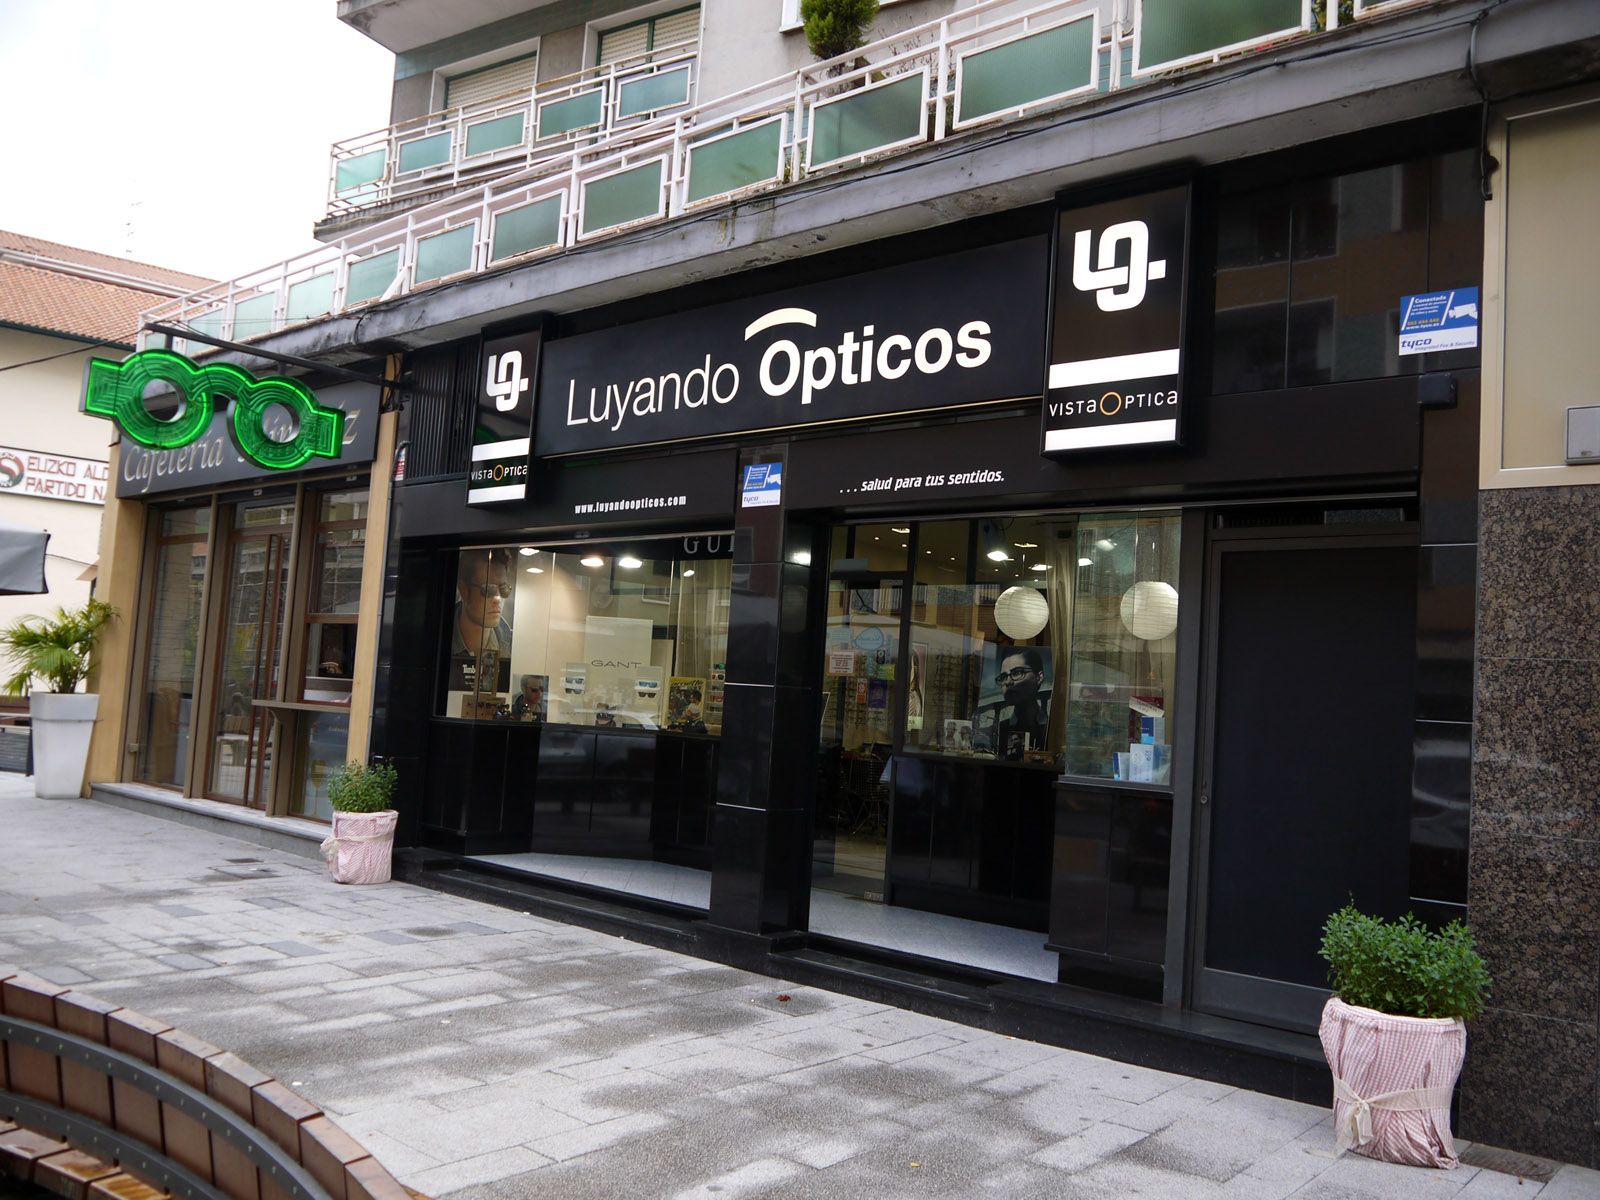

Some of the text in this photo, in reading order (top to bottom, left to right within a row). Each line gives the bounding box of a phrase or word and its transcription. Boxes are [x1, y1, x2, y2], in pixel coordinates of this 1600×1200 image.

[1401, 338, 1432, 349] tyco
[566, 354, 740, 431] Luyando
[27, 456, 76, 477] EUZKO
[25, 477, 86, 498] PARTIDO
[894, 476, 922, 491] para
[925, 474, 945, 487] tus
[948, 470, 1005, 485] sentidos.
[575, 496, 687, 514] www.luyandoopticos.com
[591, 659, 642, 669] GANT
